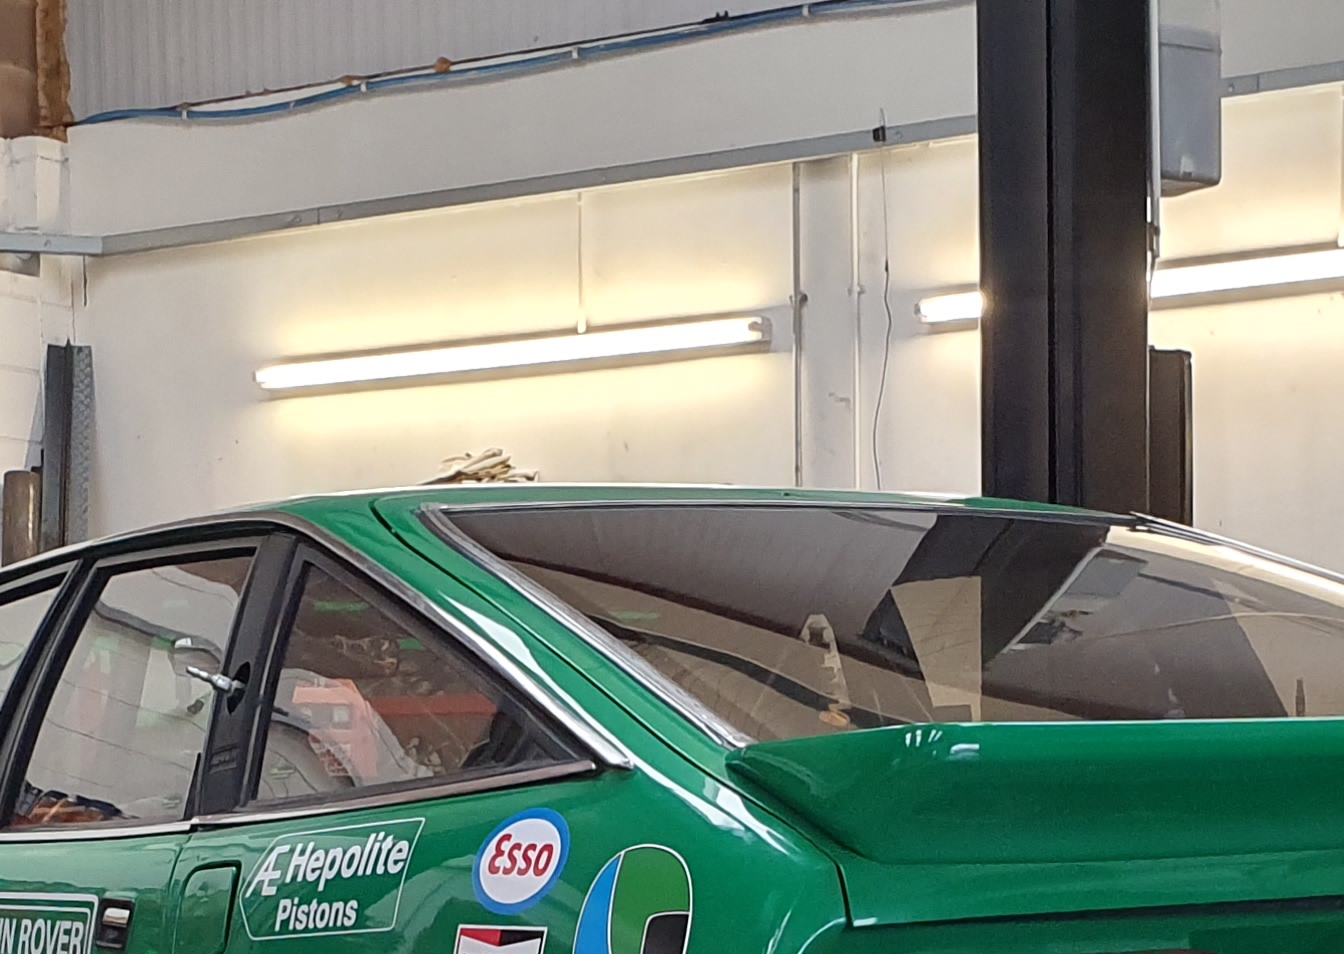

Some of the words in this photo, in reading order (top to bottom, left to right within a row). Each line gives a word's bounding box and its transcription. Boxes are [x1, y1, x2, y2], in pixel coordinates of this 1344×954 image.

[284, 832, 410, 892] Hepolite
[487, 833, 555, 878] Esso
[274, 898, 359, 932] Pistons
